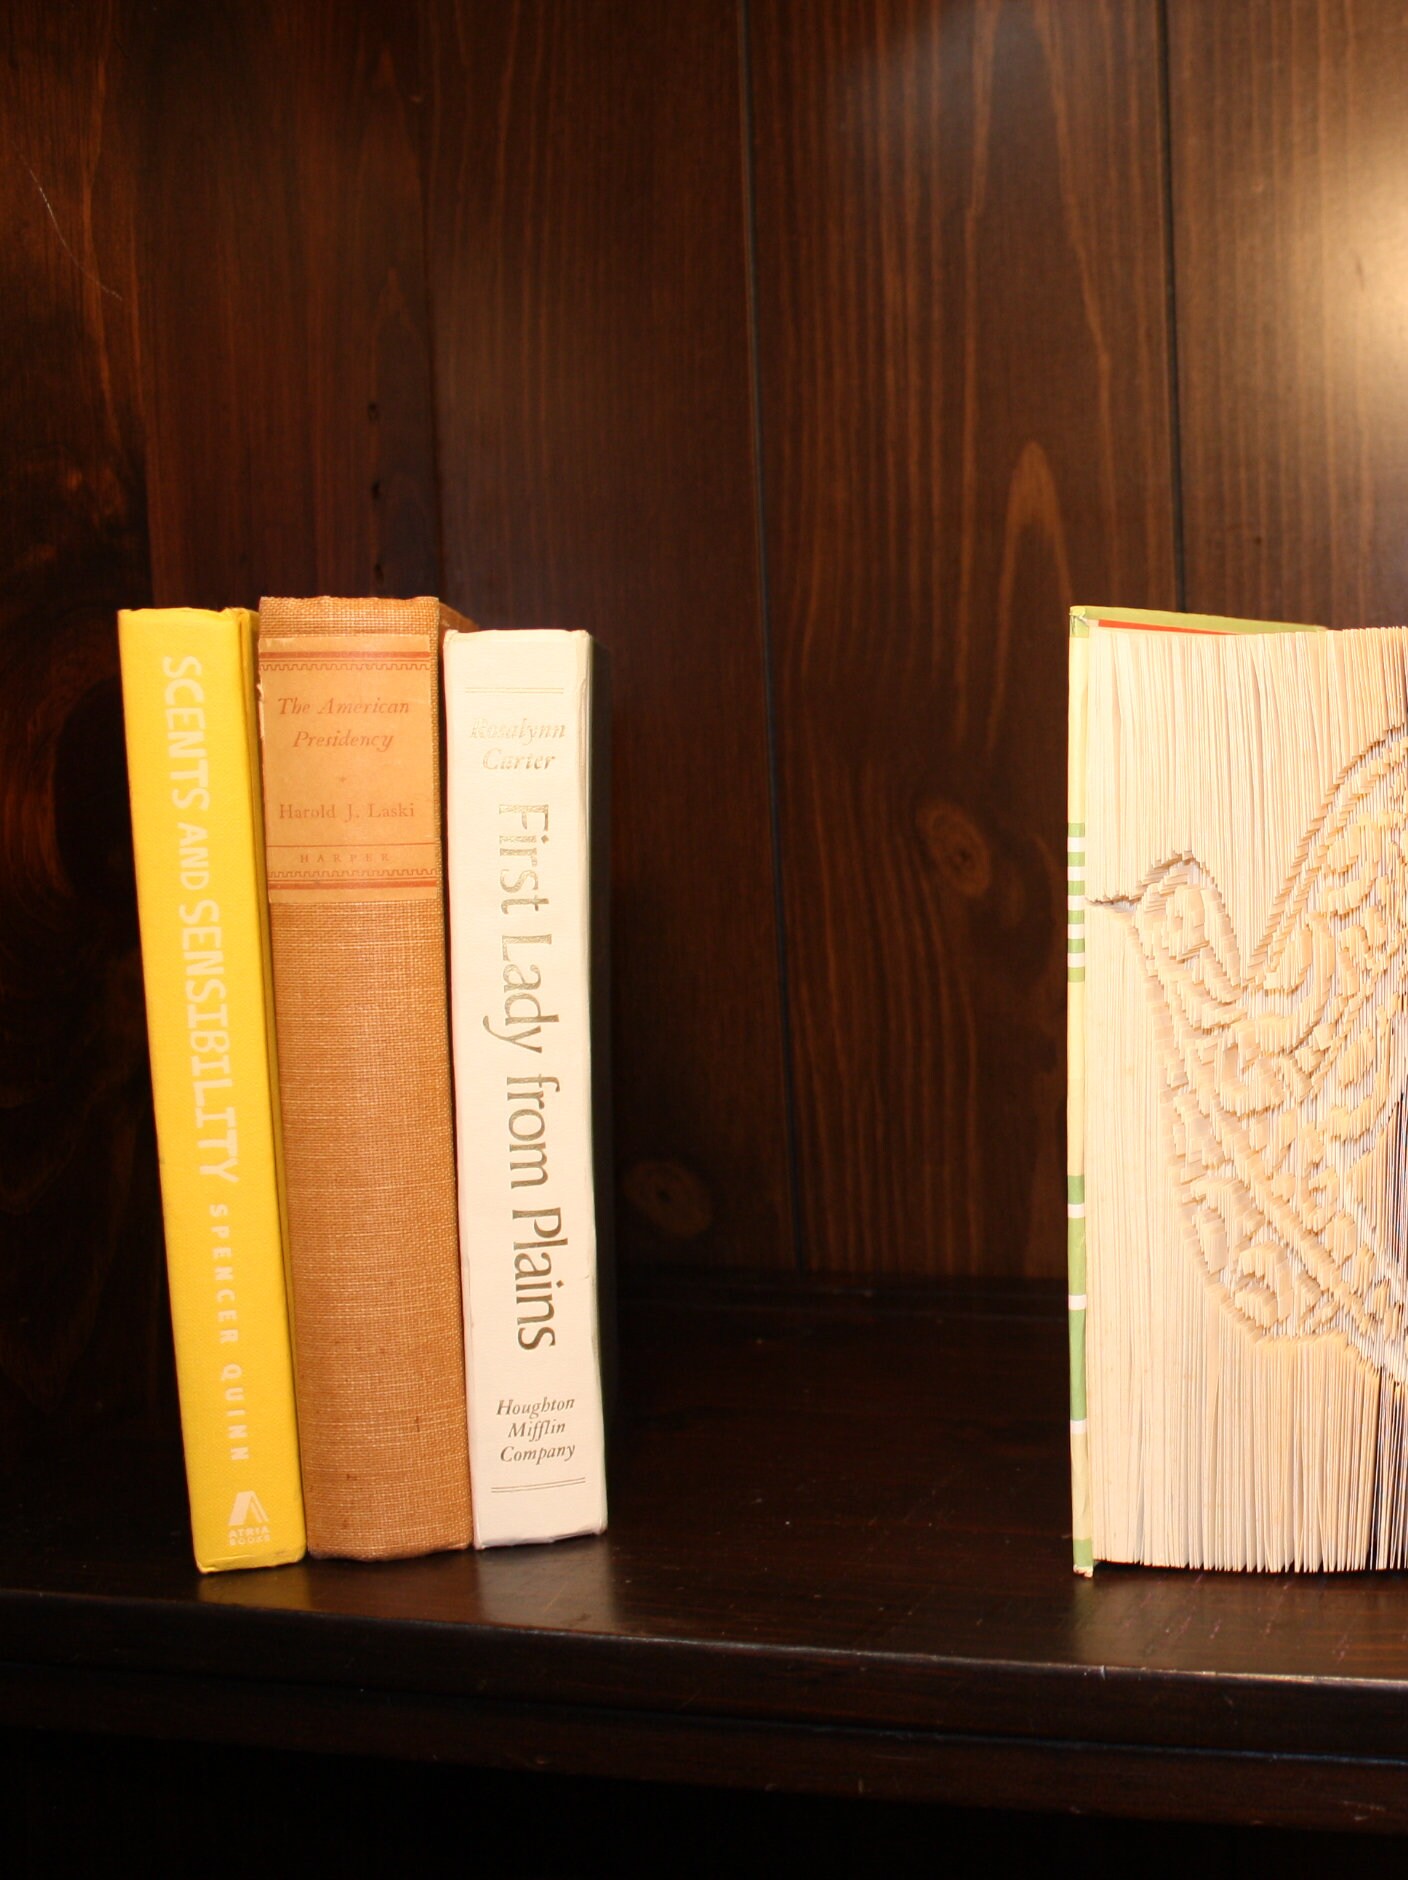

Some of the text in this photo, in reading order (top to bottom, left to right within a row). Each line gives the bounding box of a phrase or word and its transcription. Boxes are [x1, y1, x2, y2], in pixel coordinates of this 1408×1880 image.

[278, 697, 410, 715] The American
[292, 730, 394, 752] Presidency
[469, 717, 567, 745] Rosalynn
[483, 748, 556, 770] Carter
[279, 802, 415, 823] Harold J. Laski
[300, 853, 390, 864] HARPER
[162, 656, 240, 1183] SCENTS AND SENSIBILITY
[483, 804, 569, 1350] First Lady from Plains
[209, 1203, 250, 1461] SPENCER QUINN
[496, 1396, 575, 1419] Houghton
[508, 1420, 566, 1442] Mifflin
[500, 1443, 576, 1465] Company
